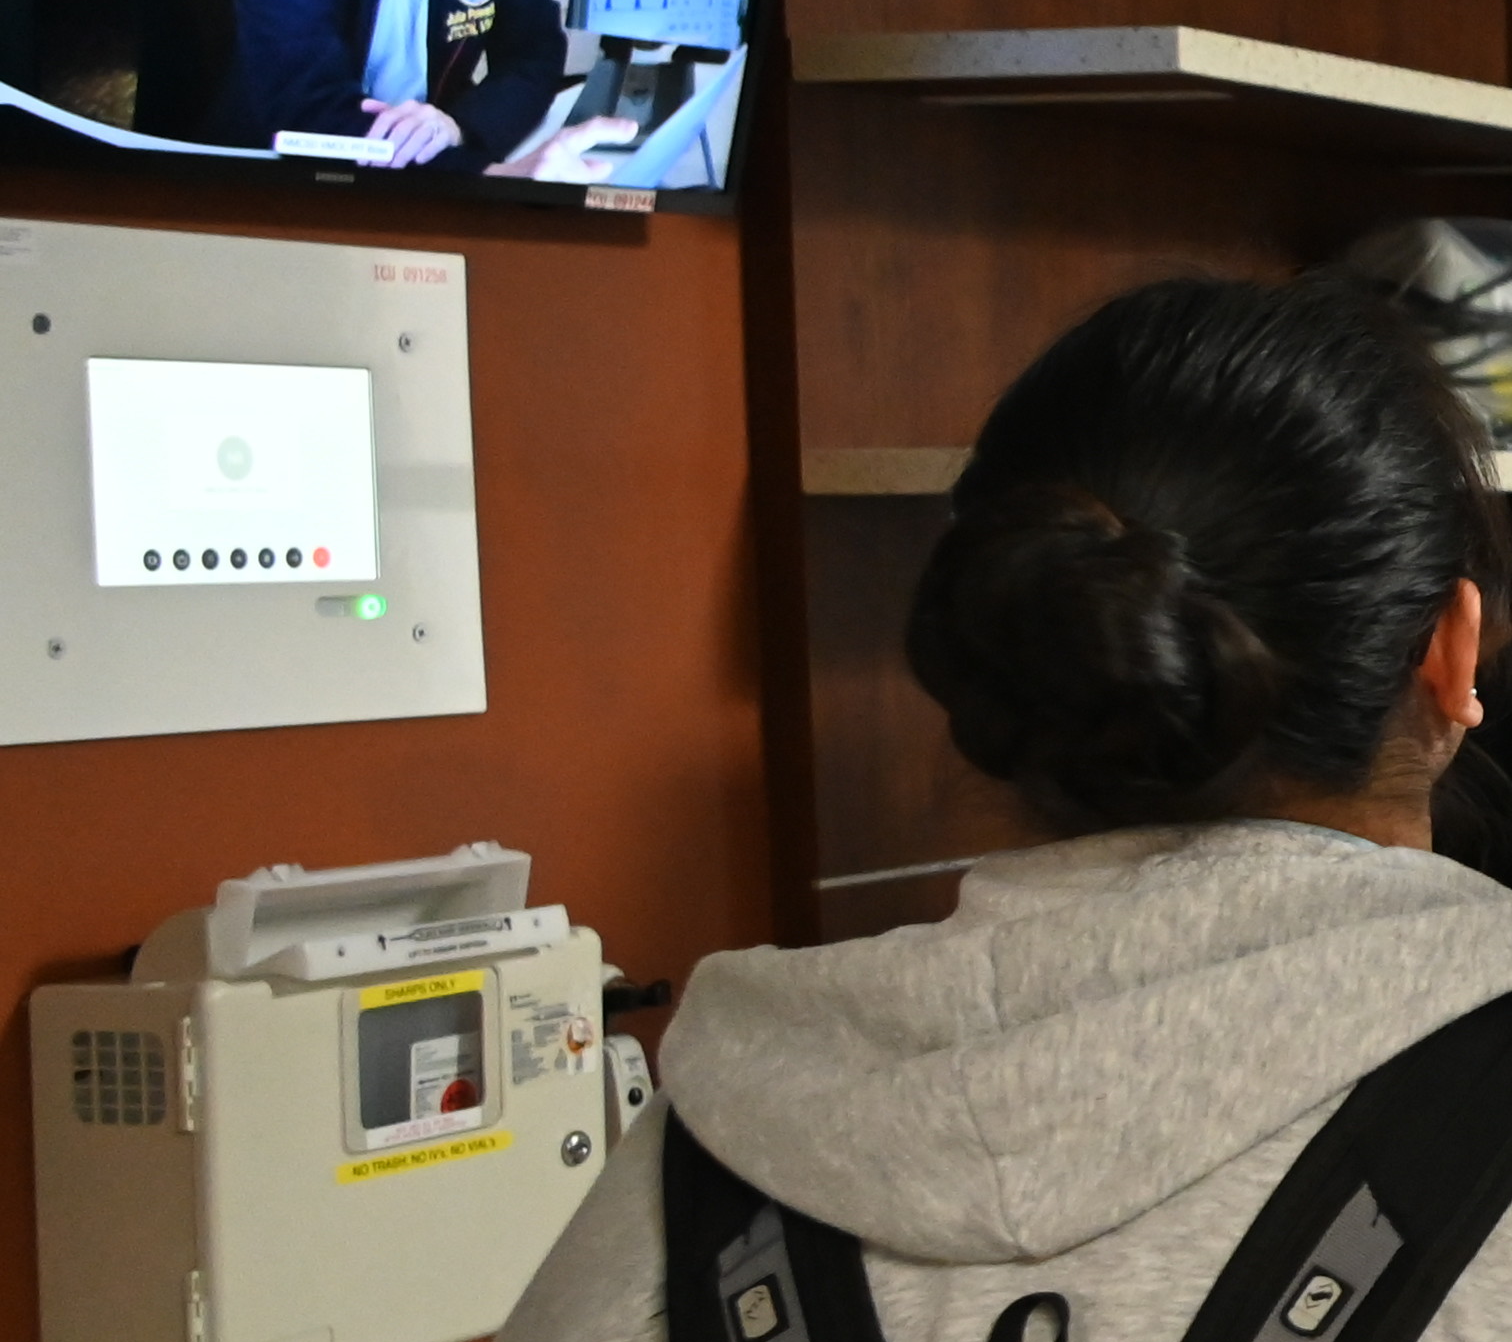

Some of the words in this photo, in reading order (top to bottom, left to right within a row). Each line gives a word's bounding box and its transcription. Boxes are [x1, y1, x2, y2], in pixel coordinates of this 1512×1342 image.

[374, 263, 397, 281] ICU
[384, 982, 428, 1001] SHARPS
[429, 978, 456, 994] ONLY
[352, 1162, 370, 1177] NO
[410, 1150, 427, 1165] NO
[449, 1142, 466, 1156] NO
